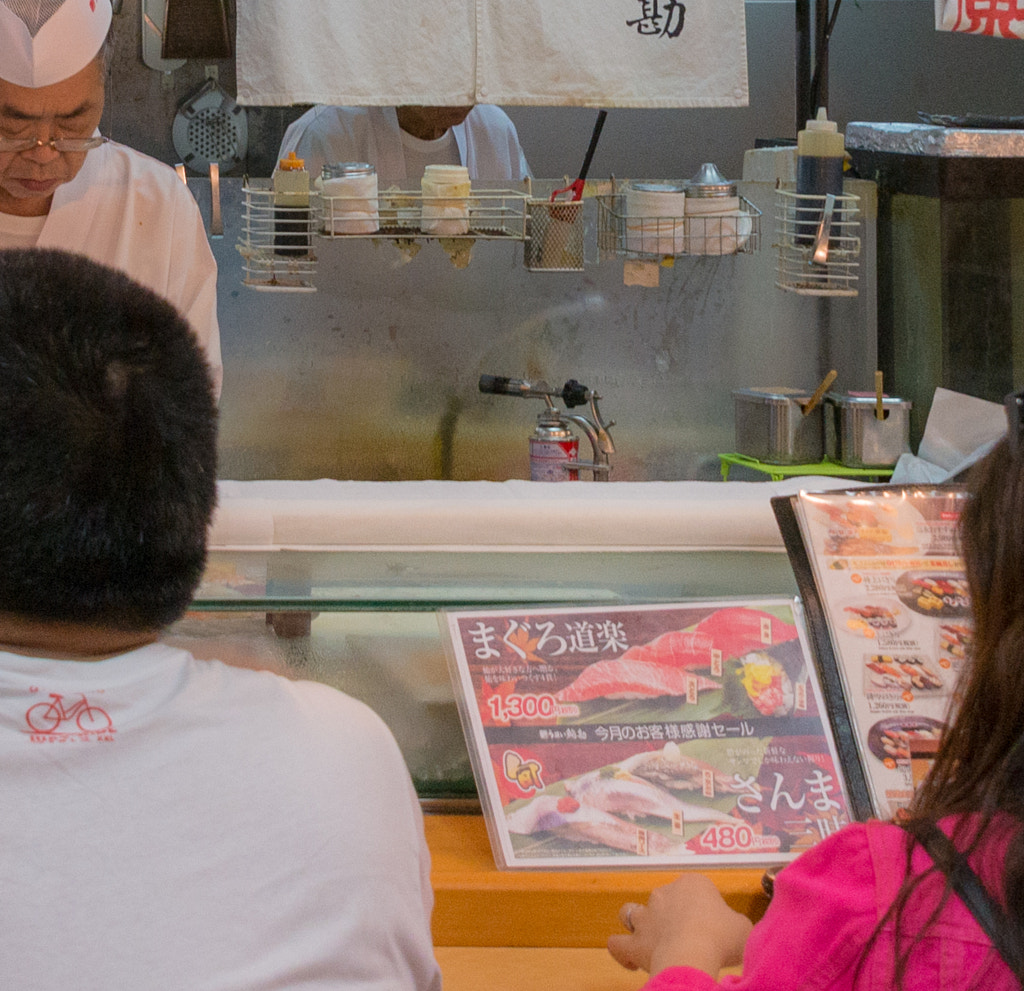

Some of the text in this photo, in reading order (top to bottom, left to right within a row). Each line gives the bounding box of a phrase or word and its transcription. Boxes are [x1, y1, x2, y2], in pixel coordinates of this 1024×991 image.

[467, 619, 630, 660] まぐろ道楽
[594, 721, 755, 742] 今月のお客様感謝セール
[729, 769, 841, 814] さんま
[701, 825, 753, 850] 480
